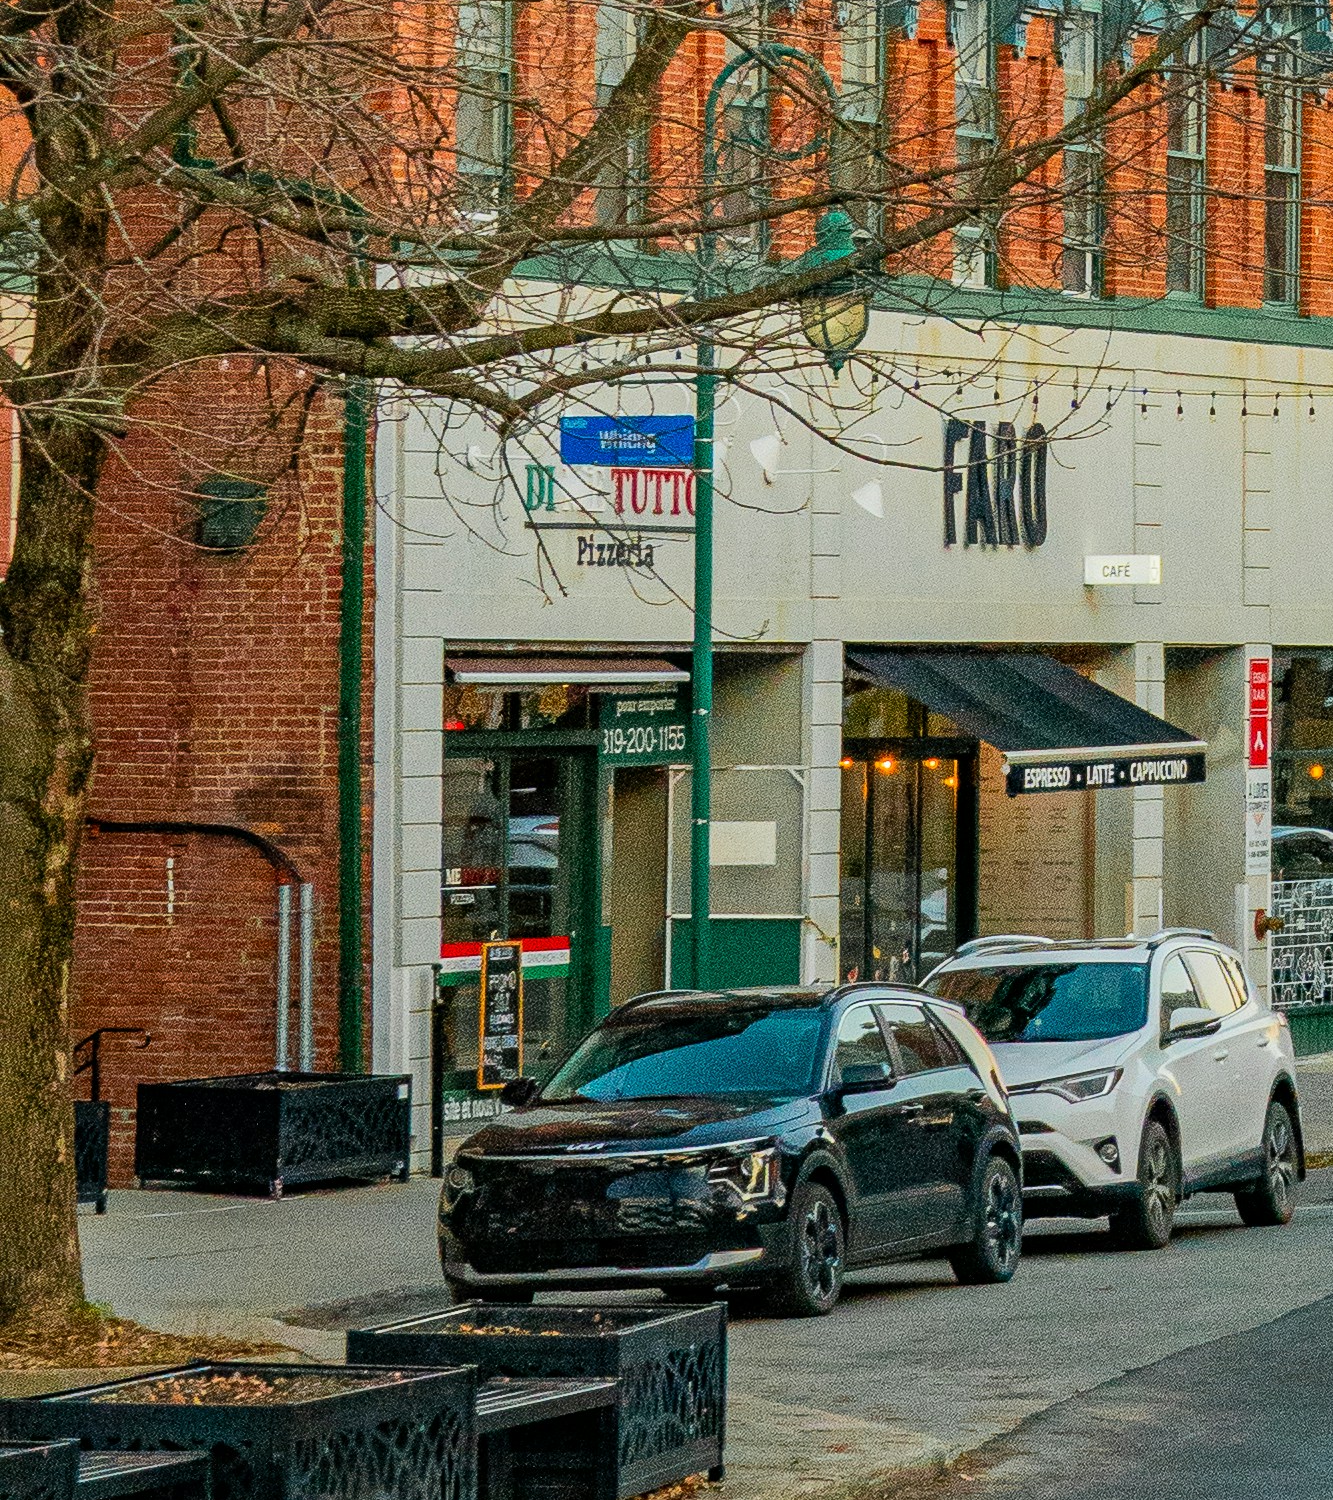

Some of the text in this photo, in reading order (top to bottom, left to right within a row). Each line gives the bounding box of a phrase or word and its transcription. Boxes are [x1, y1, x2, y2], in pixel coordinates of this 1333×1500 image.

[943, 419, 1048, 551] FARO
[577, 533, 655, 566] Pizzeria
[1101, 562, 1132, 578] CAFÉ
[1024, 759, 1188, 788] ESPRESSO LATTE CAPPUCCINO
